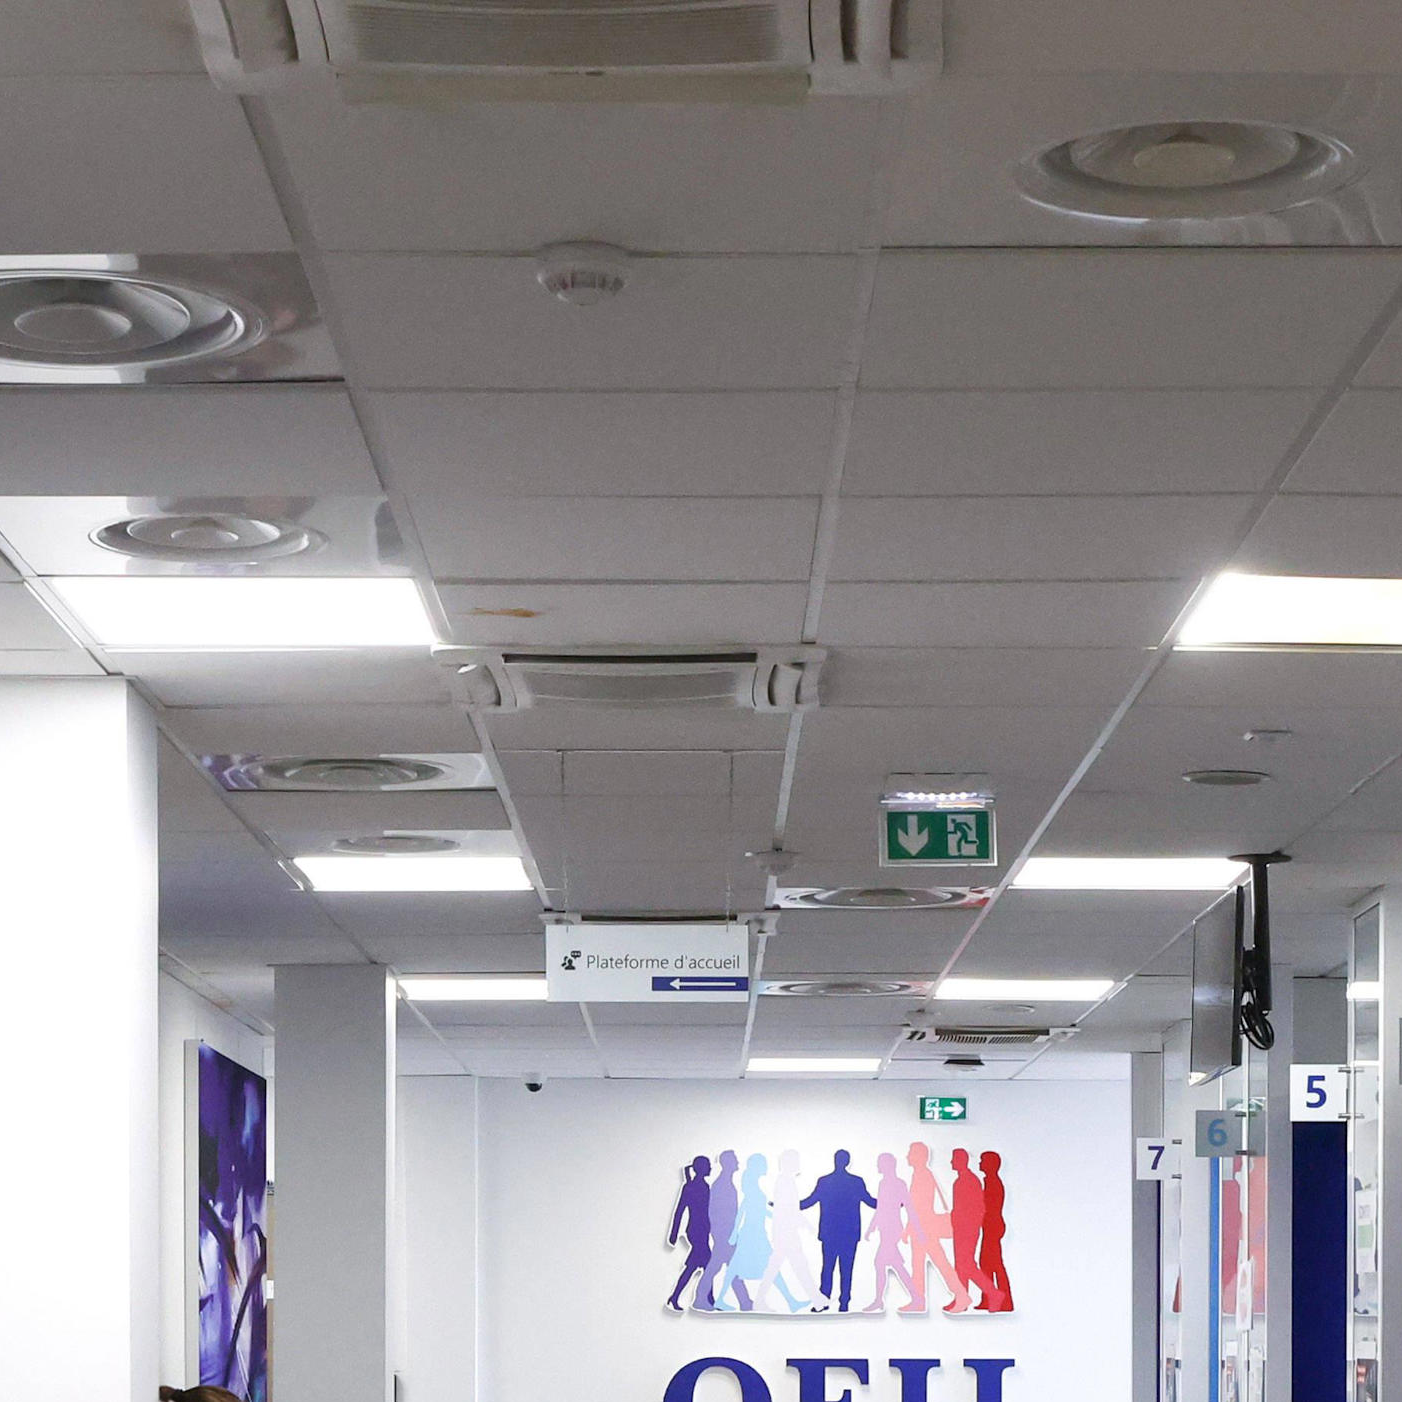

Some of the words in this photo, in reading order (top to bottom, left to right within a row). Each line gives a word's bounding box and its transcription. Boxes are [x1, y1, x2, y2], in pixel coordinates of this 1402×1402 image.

[586, 953, 669, 970] Plateforme
[674, 954, 740, 970] d'accueil
[1305, 1075, 1327, 1109] 5
[1207, 1118, 1229, 1147] 6
[1147, 1145, 1165, 1171] 7
